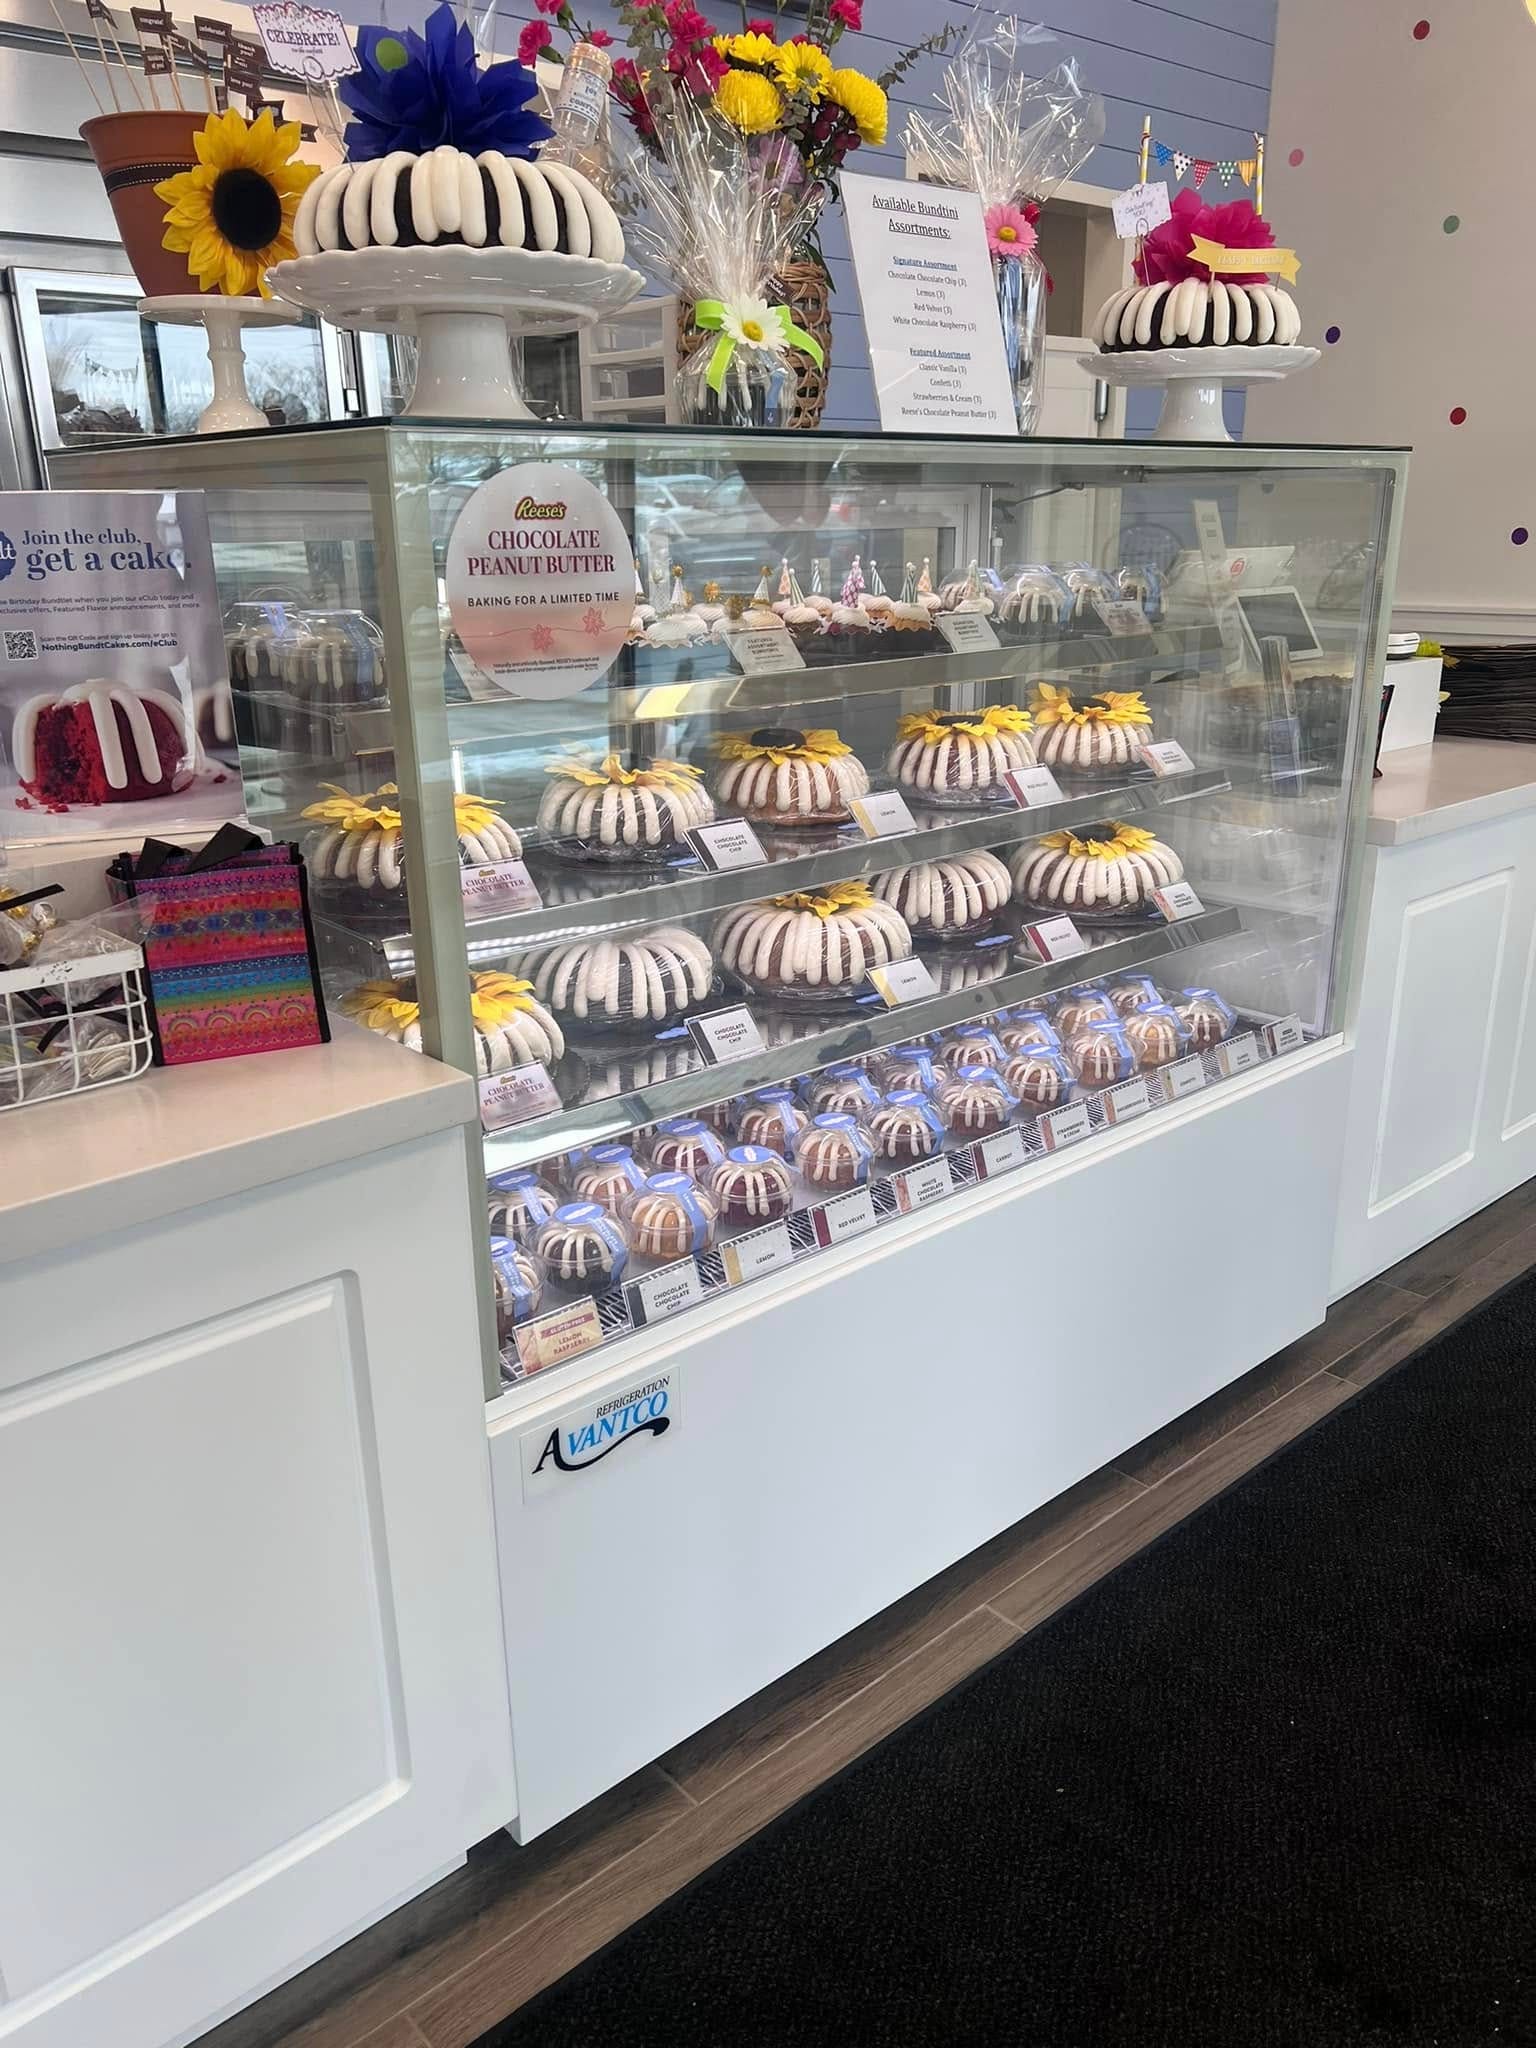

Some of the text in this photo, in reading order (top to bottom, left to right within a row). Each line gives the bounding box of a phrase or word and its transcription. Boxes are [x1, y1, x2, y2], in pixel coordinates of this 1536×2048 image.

[266, 28, 341, 46] CELEBRATE!
[872, 194, 960, 219] Available Bundtini
[888, 217, 952, 239] Assortments:
[892, 255, 922, 267] Signature
[887, 270, 916, 280] Chocolate
[917, 273, 944, 283] Chocolate
[915, 287, 935, 298] Lemon
[913, 302, 926, 312] Red
[892, 315, 911, 325] White
[911, 317, 939, 328] Chocolate
[939, 320, 968, 331] Raspberry
[918, 363, 938, 371] Classic
[939, 365, 958, 373] Vanilla
[912, 392, 949, 402] Strawberries
[923, 407, 950, 417] Chocolate
[22, 528, 142, 547] Join the club,
[488, 529, 600, 550] CHOCOLATE
[26, 548, 77, 581] get
[84, 551, 104, 572] a
[467, 554, 616, 577] PEANUT BUTTER
[468, 591, 620, 608] BAKING FOR A LIMITED TIME
[41, 639, 178, 652] NothingBundtCakes.com/eClub
[466, 872, 513, 887] CHOCOLATE
[494, 880, 525, 890] BUTTER
[714, 1023, 745, 1035] CHOCOLATE
[717, 1028, 748, 1040] CHOCOLATE
[483, 1083, 545, 1106] PEANUT BUTTER
[487, 1078, 533, 1096] CHOCOLATE
[917, 1181, 944, 1196] CHOCOLATE
[838, 1213, 866, 1229] RED VELVET
[756, 1252, 776, 1265] LEMON
[653, 1282, 688, 1301] CHOCOLATE
[655, 1289, 690, 1308] CHOCOLATE
[667, 1300, 681, 1310] CHIP
[553, 1336, 590, 1355] RASPBERRY
[558, 1332, 583, 1345] LEMON
[595, 1376, 671, 1418] REFRIGERATION
[531, 1390, 670, 1475] AVANTCO
